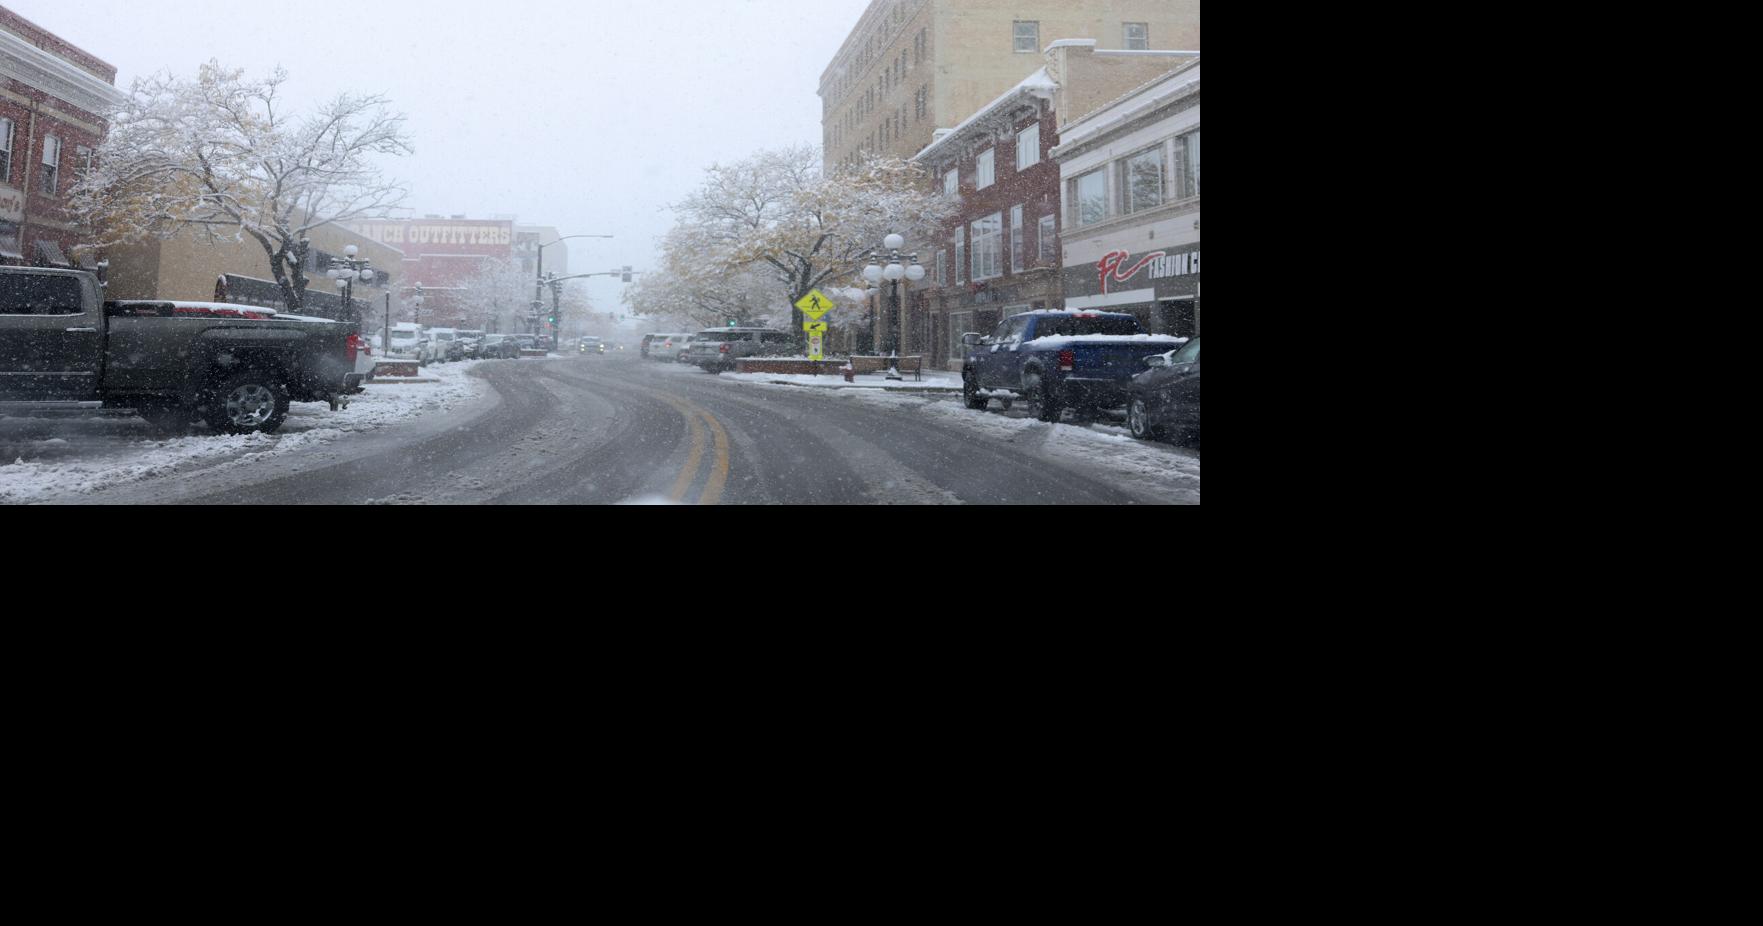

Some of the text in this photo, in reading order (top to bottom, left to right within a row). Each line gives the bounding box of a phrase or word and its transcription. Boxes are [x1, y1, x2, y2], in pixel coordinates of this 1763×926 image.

[409, 224, 510, 245] OUTFITTERS
[1097, 249, 1166, 296] FC
[1148, 251, 1200, 279] FASHION C
